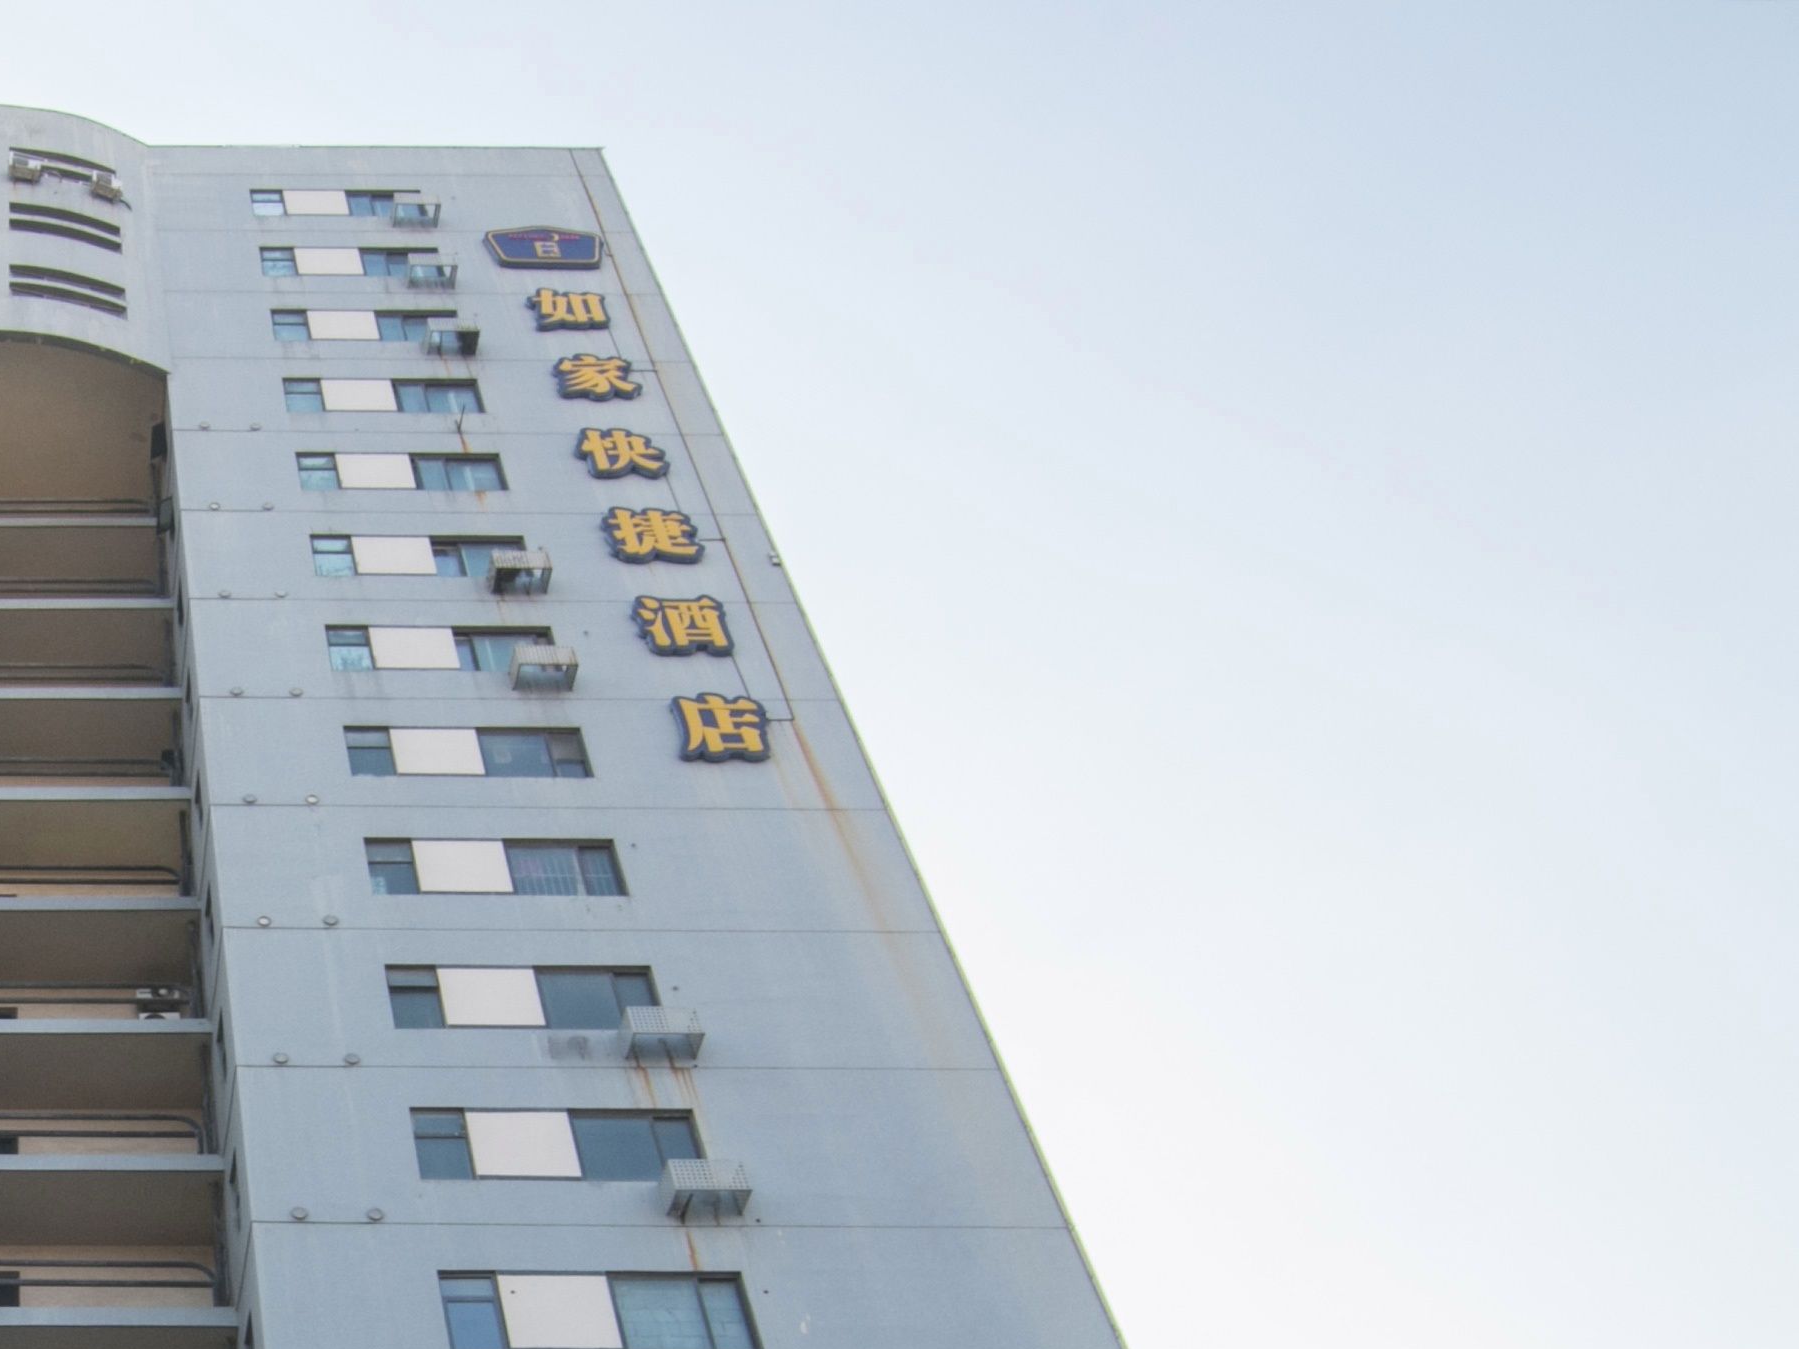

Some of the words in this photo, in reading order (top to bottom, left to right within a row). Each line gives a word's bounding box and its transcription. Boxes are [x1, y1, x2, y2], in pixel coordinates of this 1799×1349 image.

[527, 287, 771, 763] 如家快捷酒店
